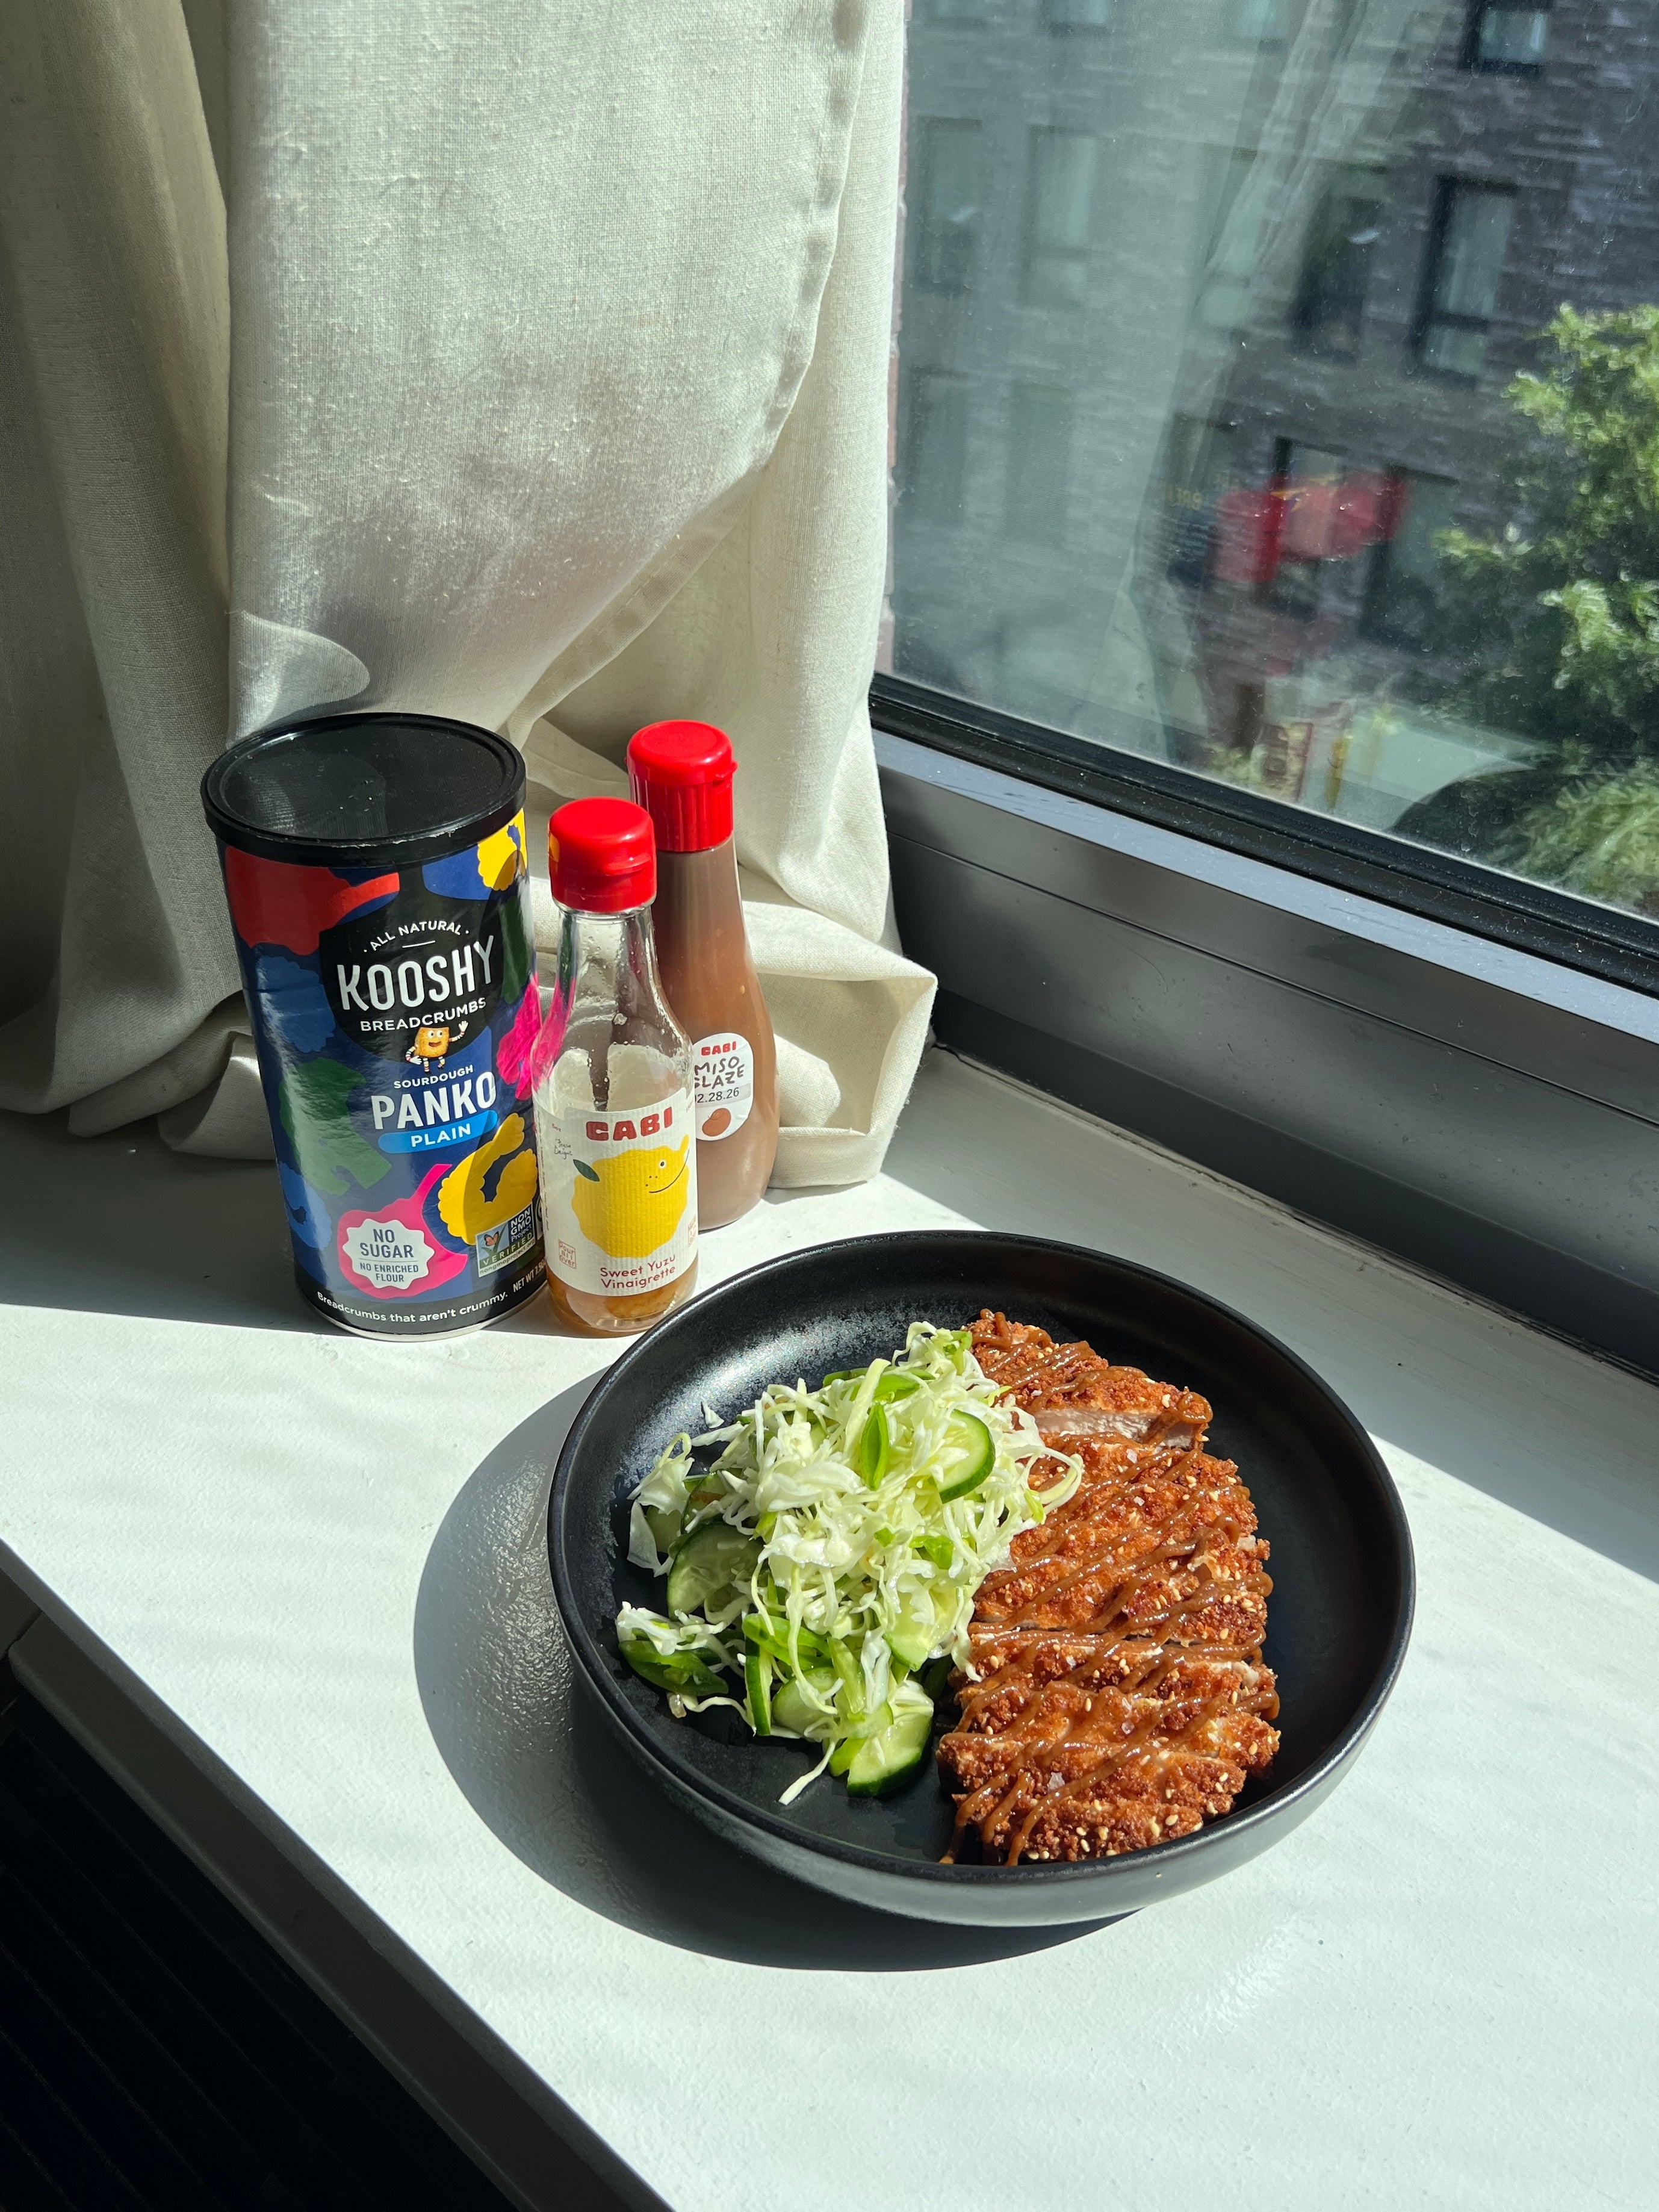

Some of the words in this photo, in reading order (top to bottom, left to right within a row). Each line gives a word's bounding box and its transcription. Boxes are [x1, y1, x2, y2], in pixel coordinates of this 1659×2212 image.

[370, 931, 396, 951] ALL
[398, 920, 462, 937] NATURAL
[337, 934, 494, 1011] KOOSHY
[360, 997, 486, 1032] BREADCRUMBS
[701, 1041, 737, 1055] CABI
[393, 1064, 474, 1089] SOURDOUGH
[694, 1056, 740, 1075] MISO
[371, 1071, 497, 1130] PANKO
[695, 1087, 739, 1103] 2.28.26
[411, 1123, 471, 1148] PLAIN
[586, 1106, 673, 1141] CABI
[510, 1207, 531, 1228] NON
[510, 1216, 532, 1235] GMO
[373, 1228, 395, 1243] NO
[511, 1224, 532, 1243] Project
[360, 1243, 414, 1258] SUGAR
[483, 1232, 532, 1266] VERIFIED
[360, 1262, 372, 1272] NO
[374, 1264, 419, 1273] ENRICHED
[376, 1273, 405, 1283] FLOUR
[600, 1262, 643, 1278] Sweet
[648, 1254, 677, 1272] Yuzu
[600, 1265, 676, 1290] Vinaigrette
[513, 1276, 526, 1293] NET
[526, 1268, 535, 1284] WT
[317, 1291, 387, 1322] Breadcrumbs
[389, 1314, 416, 1323] that
[419, 1309, 456, 1323] aren't
[459, 1292, 509, 1314] crummy.
